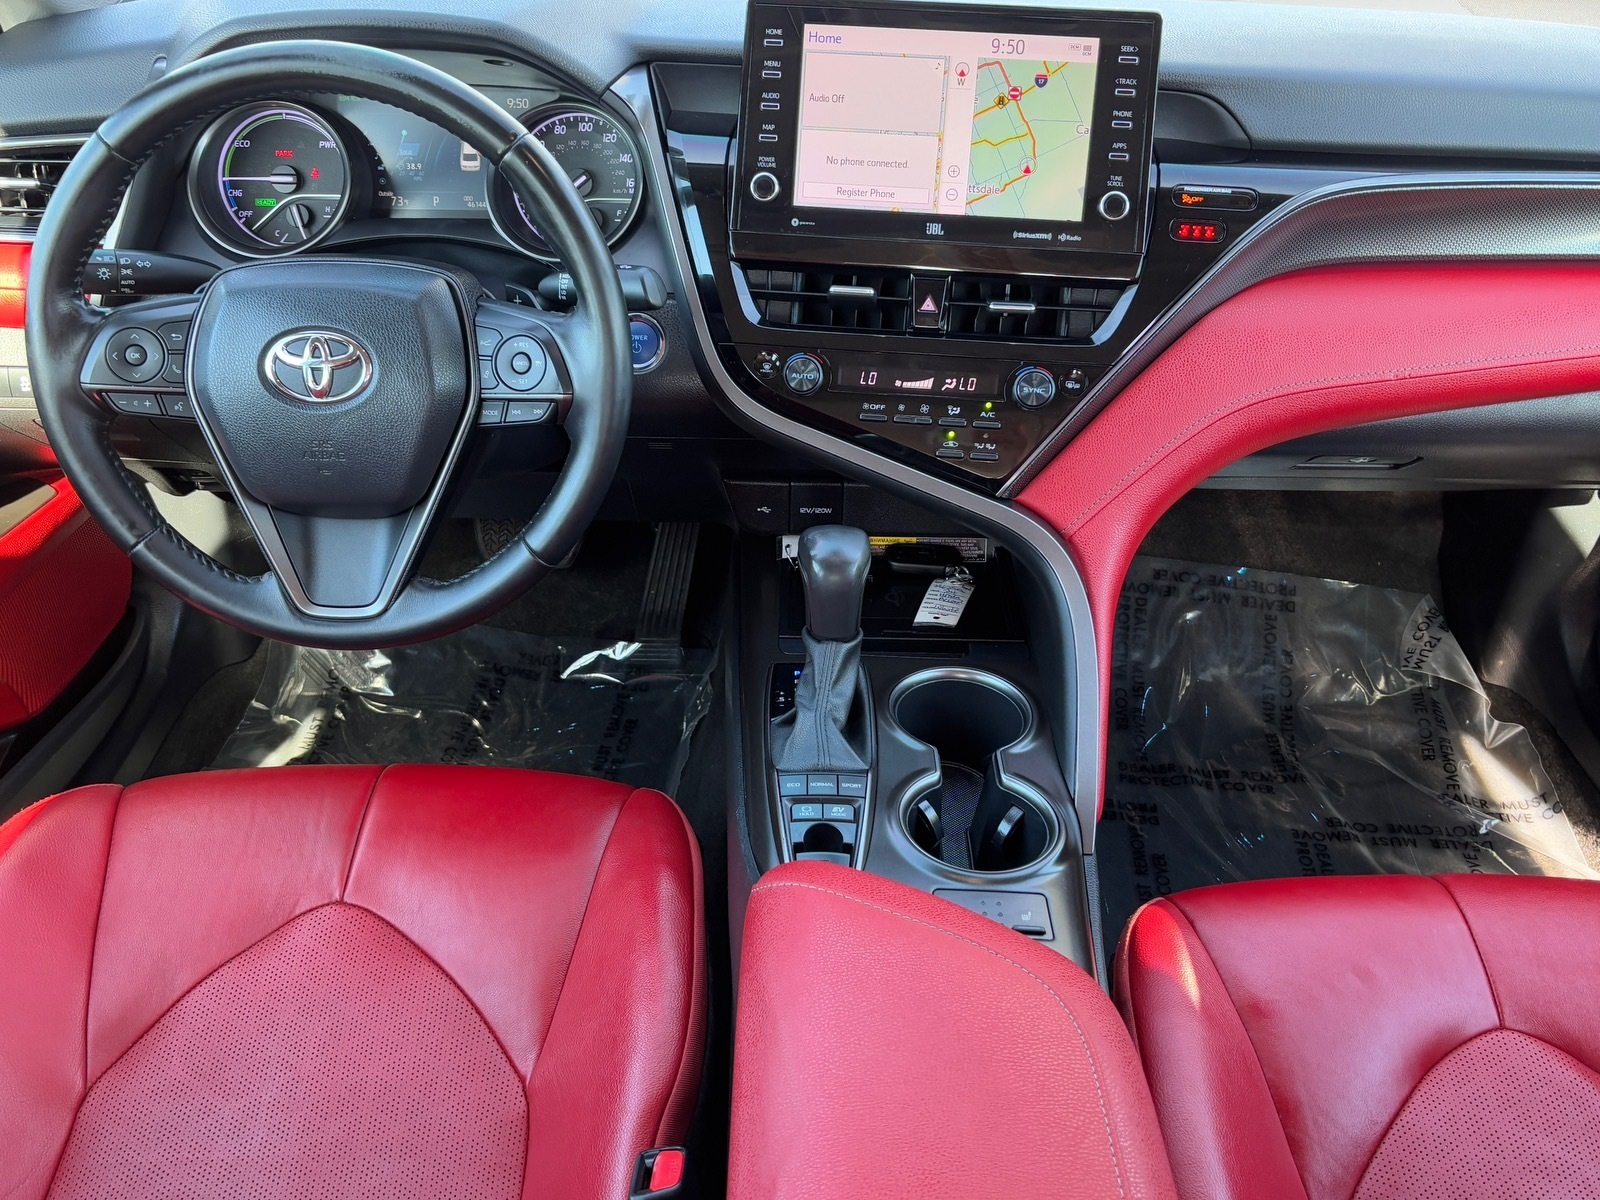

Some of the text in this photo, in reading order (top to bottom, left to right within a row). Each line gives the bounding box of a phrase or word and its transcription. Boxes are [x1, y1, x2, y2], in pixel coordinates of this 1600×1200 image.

[765, 28, 783, 36] HOME
[808, 31, 842, 44] Home
[991, 38, 1025, 55] 9:50
[507, 98, 529, 108] 9:50
[808, 93, 845, 104] Audio Off
[554, 126, 566, 134] 80
[578, 123, 593, 132] 100
[603, 134, 616, 142] 120
[620, 154, 633, 163] 140
[826, 156, 910, 169] No phone connected.
[626, 178, 635, 188] 16
[836, 186, 896, 199] Register Phone
[433, 197, 440, 206] P
[926, 222, 944, 235] JBL
[860, 371, 877, 385] LO
[959, 377, 977, 391] LO
[302, 451, 346, 461] AIRBAG
[1114, 688, 1129, 730] COVER
[1262, 686, 1276, 725] MUST
[1431, 699, 1447, 731] MUST
[1418, 718, 1435, 761] COVER
[1438, 737, 1459, 791] REMOVE
[1118, 762, 1175, 773] DEALER
[1188, 767, 1230, 780] MUST
[1119, 774, 1275, 794] PROTECTIVE COVER
[1325, 817, 1378, 831] COVER
[1291, 828, 1359, 842] REMOVE
[1372, 836, 1417, 847] MUST
[1152, 853, 1172, 895] COVER
